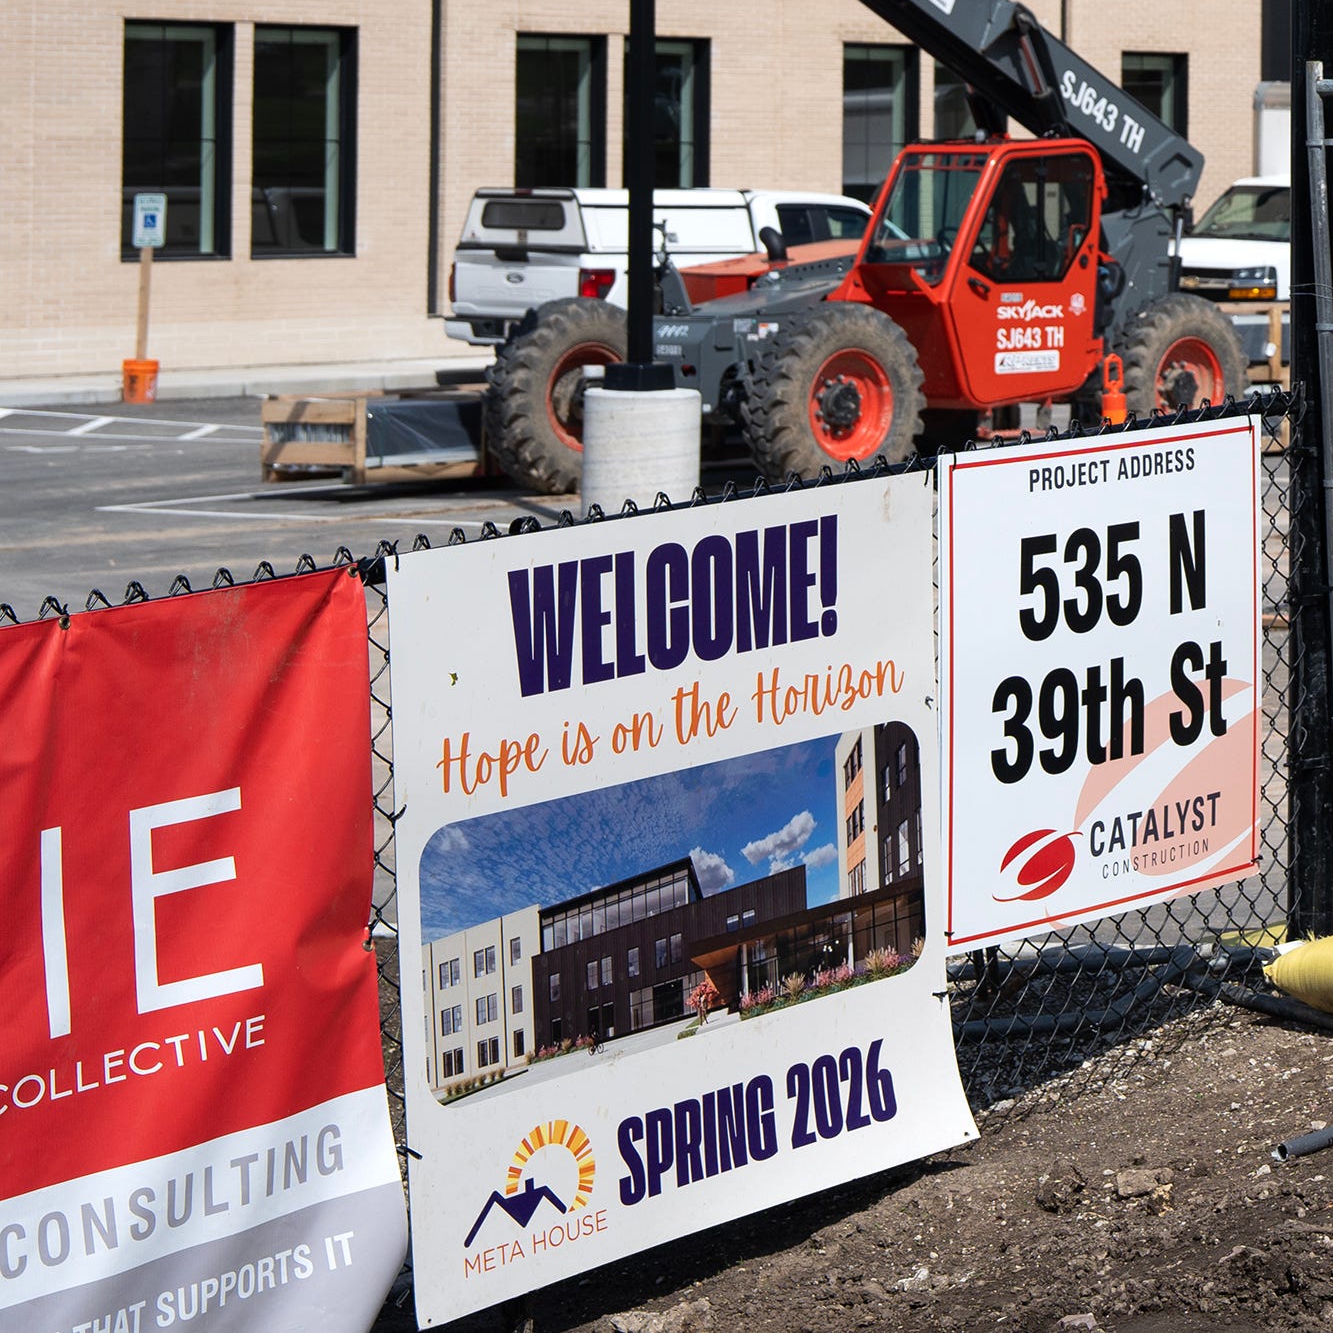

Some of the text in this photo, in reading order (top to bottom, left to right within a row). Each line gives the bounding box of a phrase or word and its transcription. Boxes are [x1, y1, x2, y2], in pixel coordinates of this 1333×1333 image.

[1061, 70, 1145, 154] SJ643 TH
[996, 299, 1065, 321] SKYJACK
[996, 325, 1065, 349] SJ643 TH
[1029, 448, 1195, 492] PROJECT ADDRESS
[507, 514, 838, 697] WELCOME!
[1019, 509, 1206, 642] 535 N
[436, 660, 905, 798] Hope is on the Horizon
[990, 641, 1227, 785] 39th St
[1090, 792, 1221, 858] CATALYST
[1102, 839, 1209, 879] CONSTRUCTION
[617, 1039, 898, 1206] SPRING 2026
[0, 1124, 344, 1280] CONSULTING
[464, 1209, 608, 1278] META HOUSE
[157, 1243, 314, 1327] SUPPORTS
[325, 1231, 354, 1271] IT
